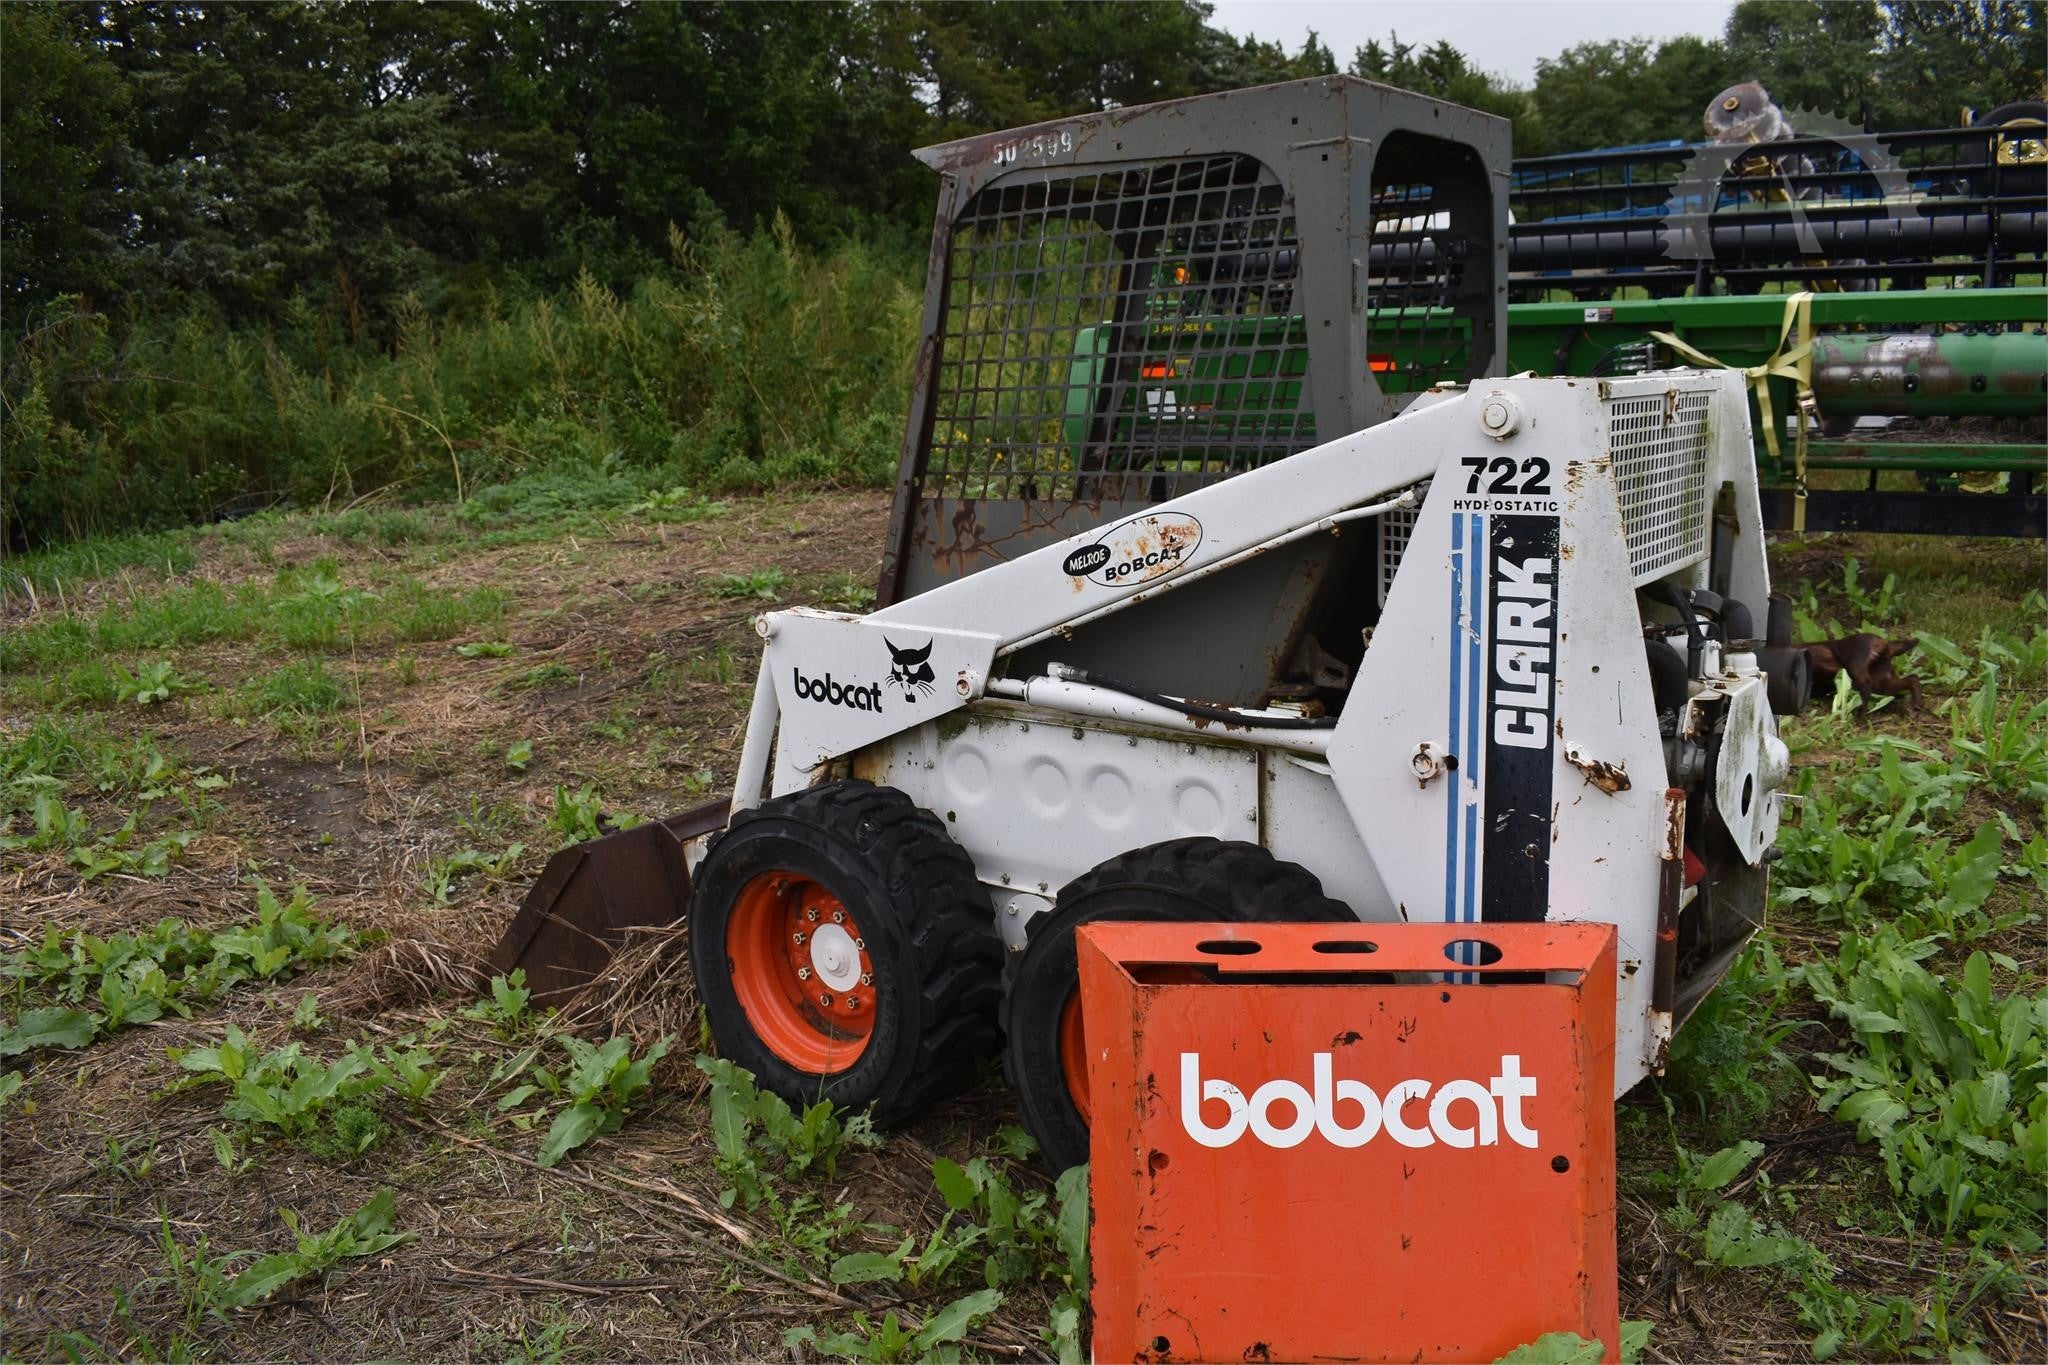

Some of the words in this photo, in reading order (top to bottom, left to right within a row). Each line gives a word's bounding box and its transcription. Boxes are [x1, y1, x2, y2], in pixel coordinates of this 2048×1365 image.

[1461, 456, 1551, 495] 722
[1453, 499, 1560, 512] HYDROSTATIC
[1069, 548, 1107, 572] MELROE
[1105, 545, 1184, 581] BOBCAT
[1494, 555, 1552, 750] CLARK
[793, 667, 883, 714] bobcat
[1180, 1052, 1539, 1149] bobcat
